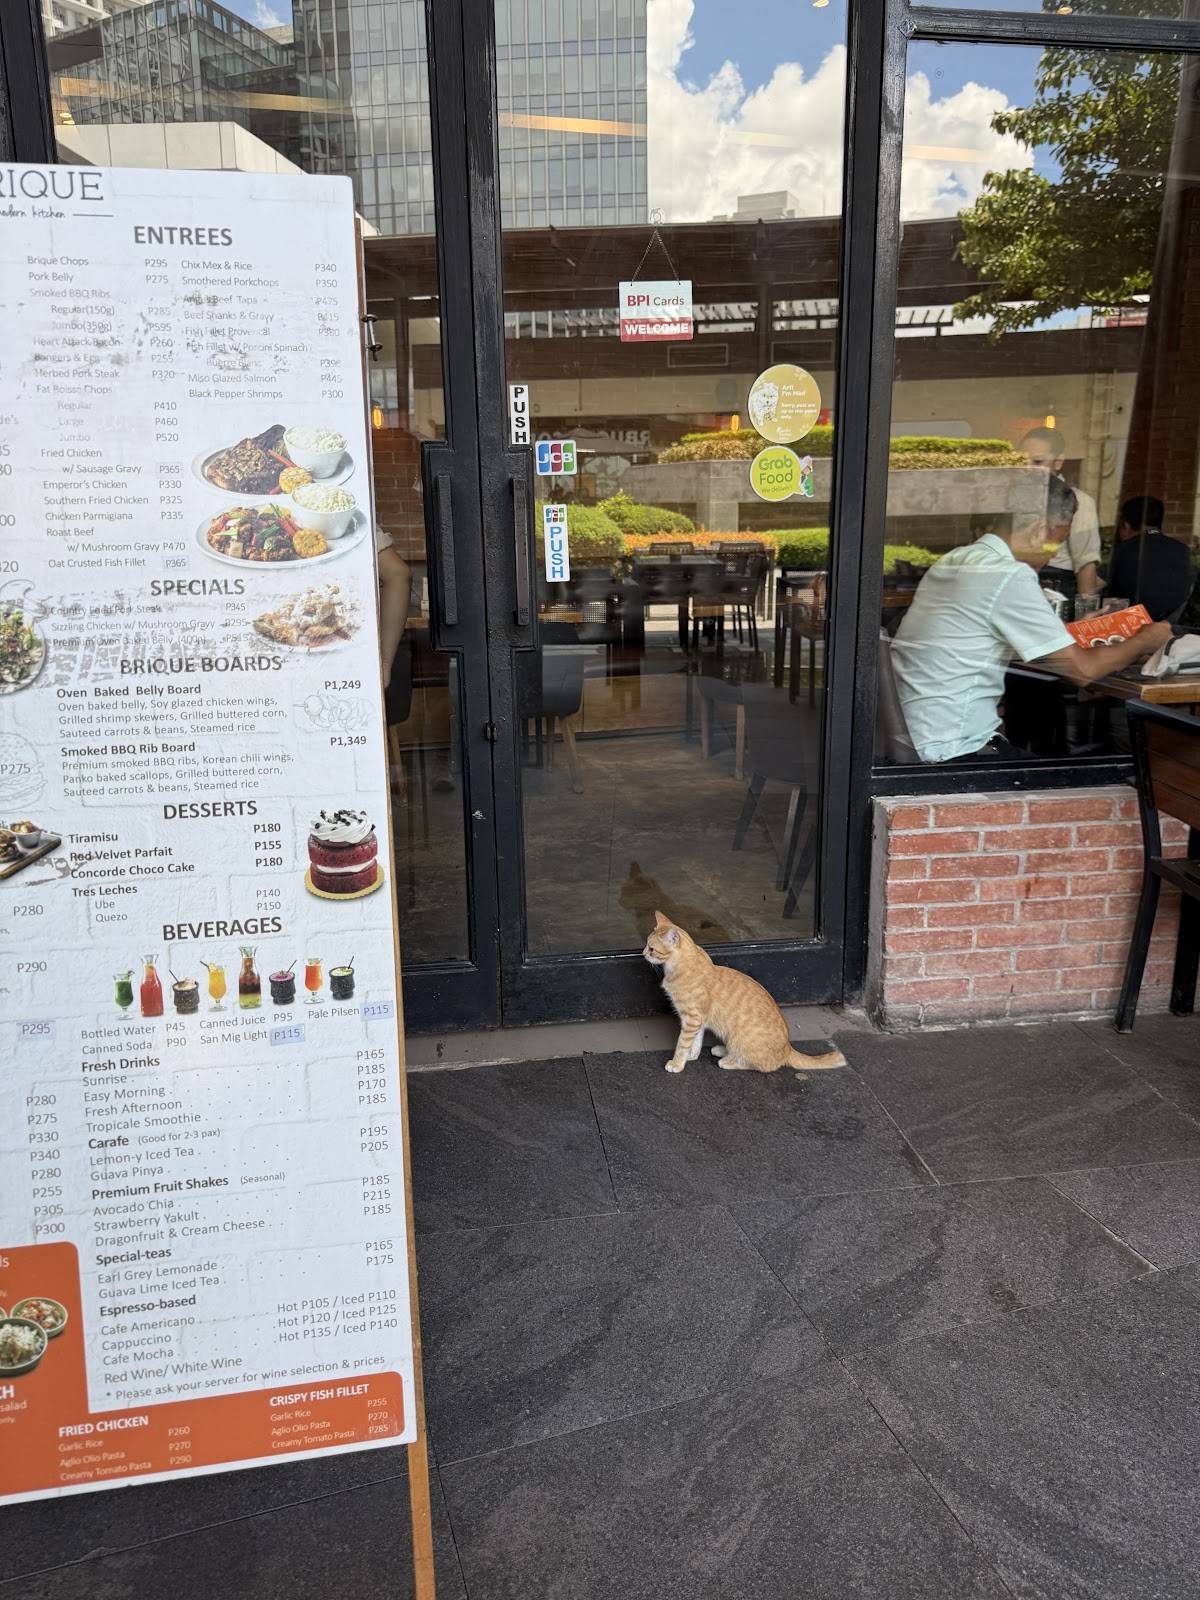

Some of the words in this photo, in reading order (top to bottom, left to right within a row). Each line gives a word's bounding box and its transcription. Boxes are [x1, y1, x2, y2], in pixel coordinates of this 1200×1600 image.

[0, 169, 103, 200] IQUE
[32, 205, 65, 218] kitchen
[134, 226, 232, 246] ENTREES
[27, 254, 58, 266] Brique
[59, 256, 89, 267] Chops
[144, 258, 168, 267] P295
[181, 260, 200, 269] Chix
[201, 260, 222, 269] Mex
[224, 261, 231, 270] &
[234, 261, 252, 270] Rice
[314, 263, 336, 272] P340
[28, 271, 49, 280] Pork
[51, 272, 74, 283] Belly
[146, 275, 168, 284] P275
[182, 277, 232, 286] Smothered
[234, 277, 279, 288] Porkchops
[315, 279, 337, 288] P350
[627, 295, 650, 306] BPI
[654, 296, 684, 306] Cards
[625, 322, 688, 335] WELCOME
[189, 389, 212, 398] Black
[214, 389, 245, 400] Pepper
[247, 389, 282, 400] Shrimps
[322, 390, 343, 399] P300
[154, 401, 176, 410] P410
[514, 386, 527, 442] PUSH
[155, 417, 178, 426] P460
[156, 433, 178, 441] P520
[41, 448, 64, 457] Fried
[66, 448, 102, 457] Chicken
[758, 456, 793, 470] Grab
[62, 464, 74, 474] w/
[76, 464, 113, 475] Sausage
[115, 464, 142, 474] Gravy
[159, 466, 180, 474] P365
[43, 478, 90, 490] Emperor's
[92, 480, 127, 488] Chicken
[158, 480, 181, 488] P330
[759, 472, 793, 485] Food
[44, 496, 86, 505] Southern
[88, 495, 111, 504] Fried
[114, 495, 148, 504] Chicken
[160, 495, 182, 504] P325
[45, 511, 80, 521] Chicken
[82, 511, 133, 521] Parmigiana
[161, 511, 183, 520] P335
[46, 527, 72, 537] Roast
[74, 527, 94, 536] Beef
[66, 543, 79, 552] w/
[81, 543, 132, 552] Mushroom
[134, 542, 159, 552] Gravy
[163, 541, 185, 550] P470
[550, 526, 564, 578] PUSH
[48, 559, 65, 568] Oat
[67, 558, 102, 567] Crusted
[104, 557, 122, 567] Fish
[124, 557, 146, 568] Fillet
[165, 559, 186, 568] P365
[150, 579, 244, 596] SPECIALS
[120, 656, 195, 676] BRIQUE
[202, 655, 282, 672] BOARDS
[56, 688, 87, 698] Oven
[94, 686, 128, 696] Baked
[136, 684, 163, 696] Belly
[167, 684, 200, 694] Board
[324, 680, 360, 691] P1,249
[58, 702, 84, 711] Oven
[87, 700, 118, 711] baked
[121, 699, 147, 710] belly,
[150, 699, 168, 711] Soy
[171, 697, 203, 711] glazed
[206, 697, 244, 707] chicken
[246, 696, 277, 709] wings,
[330, 735, 366, 747] P1,349
[61, 745, 107, 756] Smoked
[111, 744, 136, 755] BBQ
[139, 743, 158, 753] Rib
[161, 741, 195, 752] Board
[0, 764, 31, 775] P275
[164, 800, 257, 819] DESSERTS
[253, 823, 280, 833] P180
[68, 832, 118, 843] Tiramisu
[254, 840, 281, 850] P155
[70, 851, 92, 862] Red
[95, 850, 131, 861] Velvet
[135, 846, 173, 858] Parfait
[255, 857, 282, 867] P180
[71, 866, 126, 879] Concorde
[129, 864, 164, 875] Choco
[167, 862, 194, 872] Cake
[72, 885, 96, 897] Tres
[99, 884, 137, 895] Leches
[256, 888, 280, 898] P140
[13, 904, 43, 916] P280
[95, 899, 115, 909] Ube
[256, 901, 281, 911] P150
[163, 916, 281, 940] BEVERAGES
[17, 960, 47, 974] P290
[308, 1009, 328, 1019] Pale
[331, 1007, 359, 1016] Pilsen
[364, 1004, 389, 1015] P115
[199, 1016, 238, 1029] Canned
[240, 1015, 265, 1025] Juice
[273, 1012, 292, 1022] P95
[22, 1023, 50, 1035] P295
[81, 1026, 120, 1039] Bottled
[123, 1023, 156, 1035] Water
[165, 1022, 185, 1032] P45
[200, 1034, 218, 1044] San
[221, 1033, 240, 1043] Mig
[243, 1030, 267, 1043] Light
[274, 1028, 300, 1040] P115
[82, 1042, 123, 1055] Canned
[126, 1039, 152, 1051] Soda
[166, 1037, 186, 1048] P90
[81, 1059, 116, 1072] Fresh
[120, 1055, 160, 1069] Drinks
[88, 1135, 129, 1149] Carafe
[138, 1133, 166, 1145] (Good
[168, 1132, 181, 1140] for
[184, 1130, 199, 1139] 2-3
[201, 1128, 221, 1140] pax)
[240, 1172, 285, 1185] (Seasonal)
[92, 1185, 150, 1199] Premium
[154, 1180, 183, 1192] Fruit
[185, 1176, 228, 1189] Shakes
[96, 1249, 171, 1267] Special-teas
[100, 1294, 196, 1318] Espresso-based
[277, 1302, 298, 1312] Hot
[301, 1297, 330, 1310] P105
[341, 1293, 364, 1304] Iced
[368, 1289, 396, 1302] P110
[101, 1324, 128, 1336] Cafe
[130, 1316, 195, 1332] Americano
[270, 1392, 307, 1406] CRISPY
[310, 1388, 334, 1400] FISH
[336, 1383, 369, 1397] FILLET
[270, 1412, 293, 1421] Garlic
[294, 1409, 311, 1417] Rice
[58, 1423, 94, 1437] FRIED
[96, 1415, 148, 1432] CHICKEN
[168, 1426, 190, 1436] P260
[58, 1441, 83, 1452] Garlic
[85, 1440, 103, 1448] Rice
